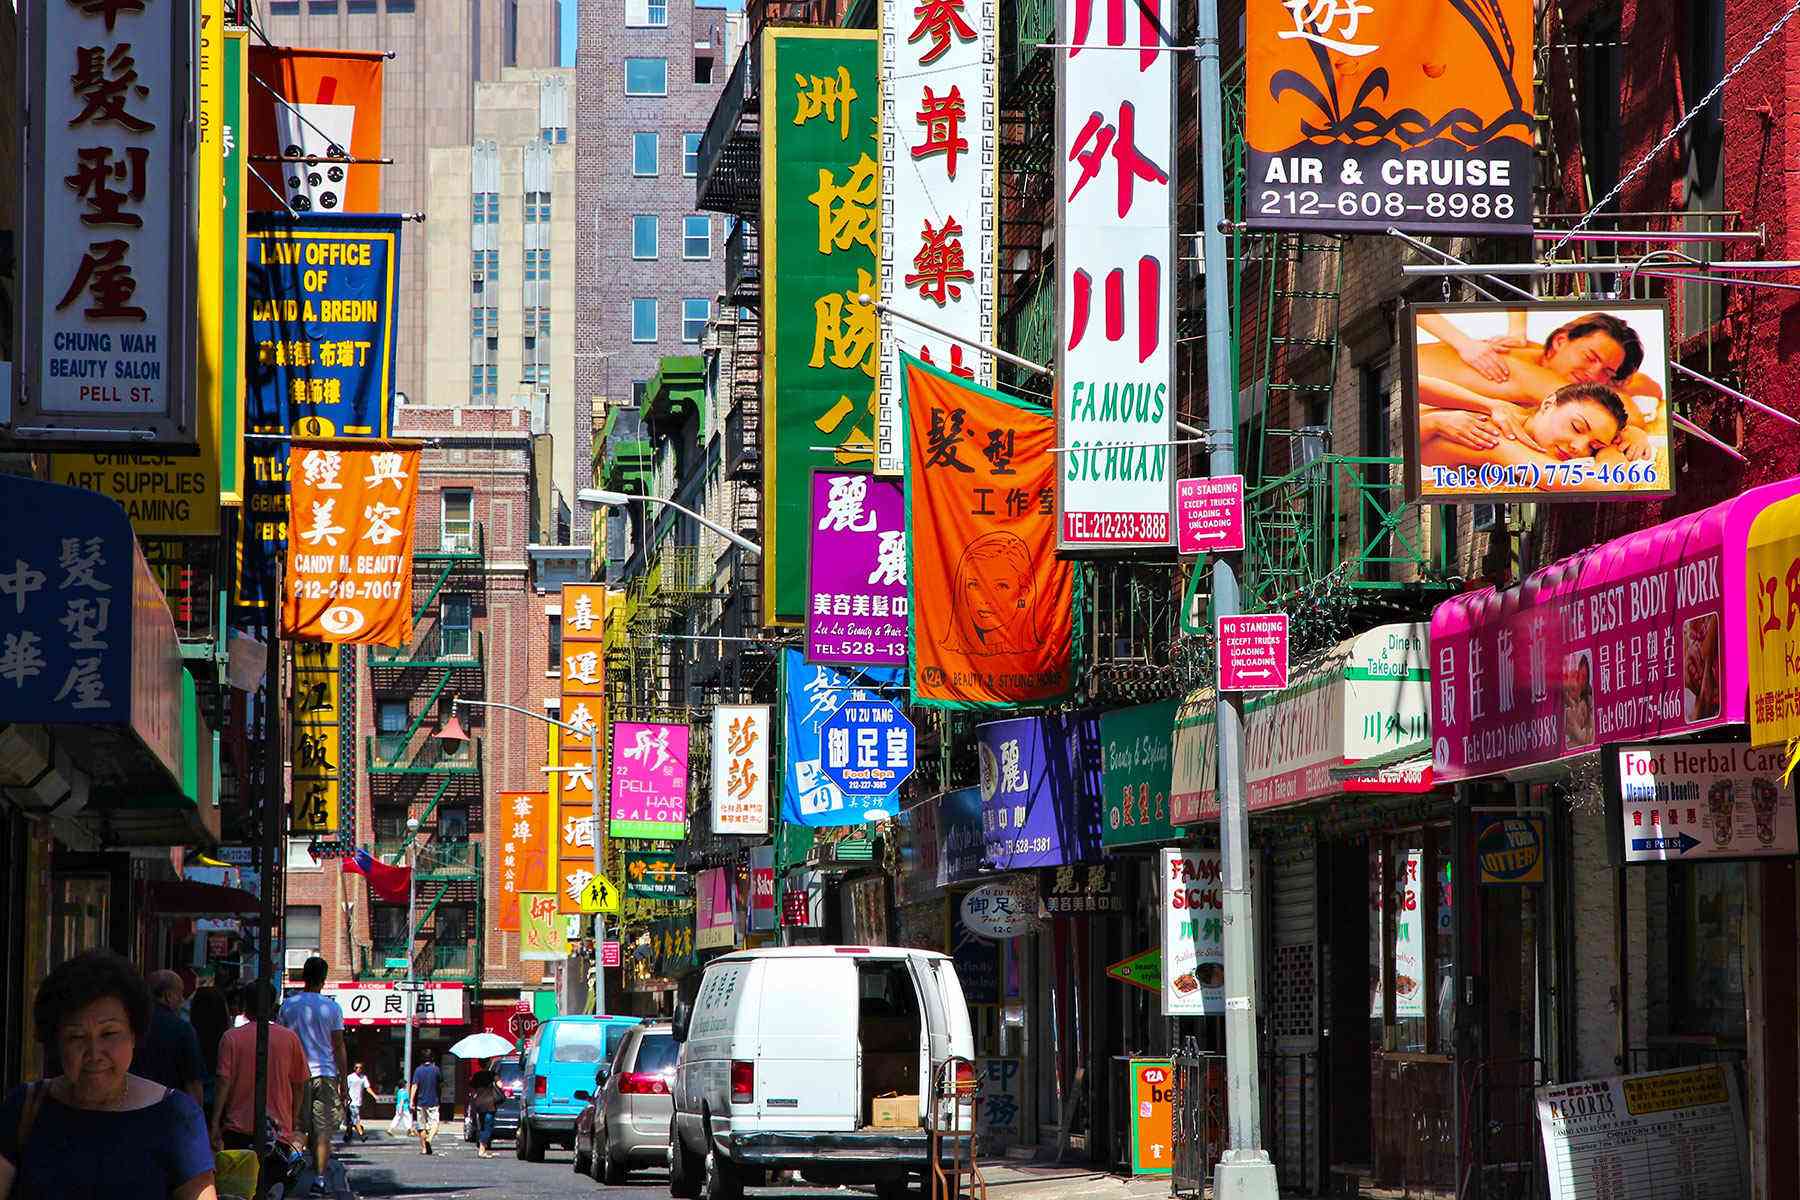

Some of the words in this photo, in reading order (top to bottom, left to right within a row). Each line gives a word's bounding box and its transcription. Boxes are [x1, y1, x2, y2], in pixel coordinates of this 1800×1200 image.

[1264, 157, 1323, 184] AIR
[1340, 158, 1364, 185] &
[1381, 158, 1511, 186] CRUISE
[1260, 190, 1515, 219] 212-608-8988
[260, 243, 301, 265] LAW
[305, 243, 371, 266] OFFICE
[303, 270, 328, 292] OF
[302, 300, 317, 322] A.
[320, 300, 378, 322] BREDIN
[54, 331, 112, 352] CHUNG
[119, 333, 157, 353] WAH
[49, 358, 108, 380] BEAUTY
[114, 359, 161, 380] SALON
[79, 386, 121, 402] PELL
[130, 387, 154, 403] ST.
[1071, 381, 1167, 425] FAMOUS
[1067, 440, 1167, 483] SICHUAN
[112, 471, 206, 494] SUPPLIES
[1181, 486, 1193, 497] NO
[1196, 483, 1238, 495] STANDING
[116, 499, 190, 522] AMING
[1184, 499, 1208, 509] EXCEPT
[1209, 498, 1236, 507] TRUCKS
[1188, 509, 1221, 520] LOADING
[1225, 508, 1232, 518] &
[1188, 519, 1232, 529] UNLOADING
[294, 554, 336, 574] CANDY
[356, 555, 404, 575] BEAUTY
[294, 580, 402, 600] 212-219-7007
[1559, 603, 1586, 644] THE
[1590, 585, 1625, 636] BEST
[1630, 571, 1669, 623] BODY
[1673, 555, 1720, 610] WORK
[814, 622, 829, 637] Lee
[831, 623, 846, 637] Lee
[847, 622, 874, 640] Beauty
[1223, 623, 1235, 634] NO
[1240, 621, 1283, 633] STANDING
[1227, 637, 1252, 647] EXCEPT
[1253, 635, 1281, 646] TRUCKS
[1388, 633, 1410, 651] Dine
[1412, 636, 1422, 651] in
[1231, 647, 1264, 657] LOADING
[1381, 650, 1388, 660] &
[1231, 657, 1276, 667] UNLOADING
[1367, 658, 1389, 676] Take
[1390, 661, 1409, 676] out
[844, 708, 858, 722] YU
[858, 708, 870, 722] ZU
[871, 708, 894, 723] TANG
[1626, 752, 1666, 776] Foot
[1674, 747, 1737, 775] Herbal
[1743, 748, 1787, 772] Care
[872, 769, 895, 780] Spa
[619, 779, 659, 798] PELL
[1625, 782, 1669, 804] Membership
[1670, 780, 1700, 801] Benefits
[615, 809, 683, 822] SALON
[1654, 838, 1671, 849] Pell
[511, 1019, 538, 1031] SOP
[1144, 1070, 1164, 1083] 12A
[1549, 1094, 1615, 1119] RESORTS
